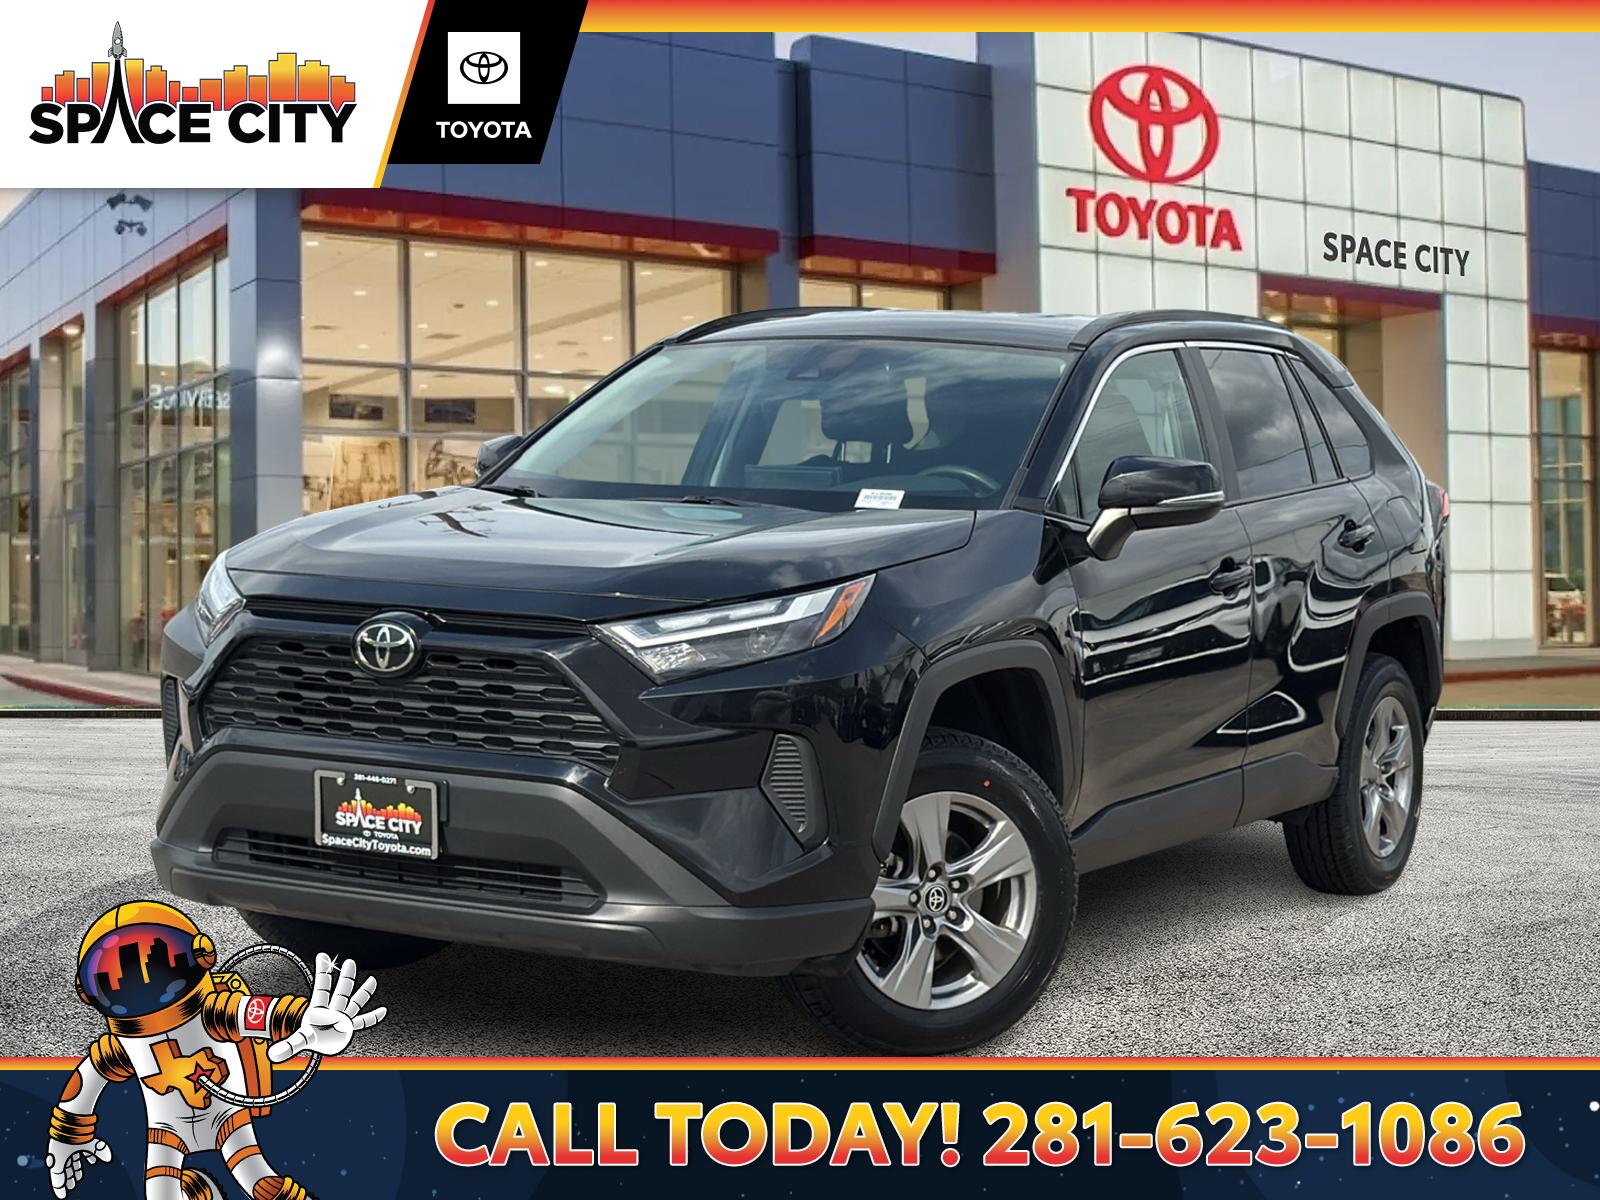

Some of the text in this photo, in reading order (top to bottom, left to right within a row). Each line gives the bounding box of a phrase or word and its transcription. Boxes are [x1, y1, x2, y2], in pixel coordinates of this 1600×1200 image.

[1065, 187, 1242, 251] TOYOTA
[1323, 232, 1470, 277] SPACE CITY
[335, 800, 422, 835] SPACE CITY
[373, 830, 399, 840] TOYOTA
[321, 833, 431, 856] SpaceCityToyota.com
